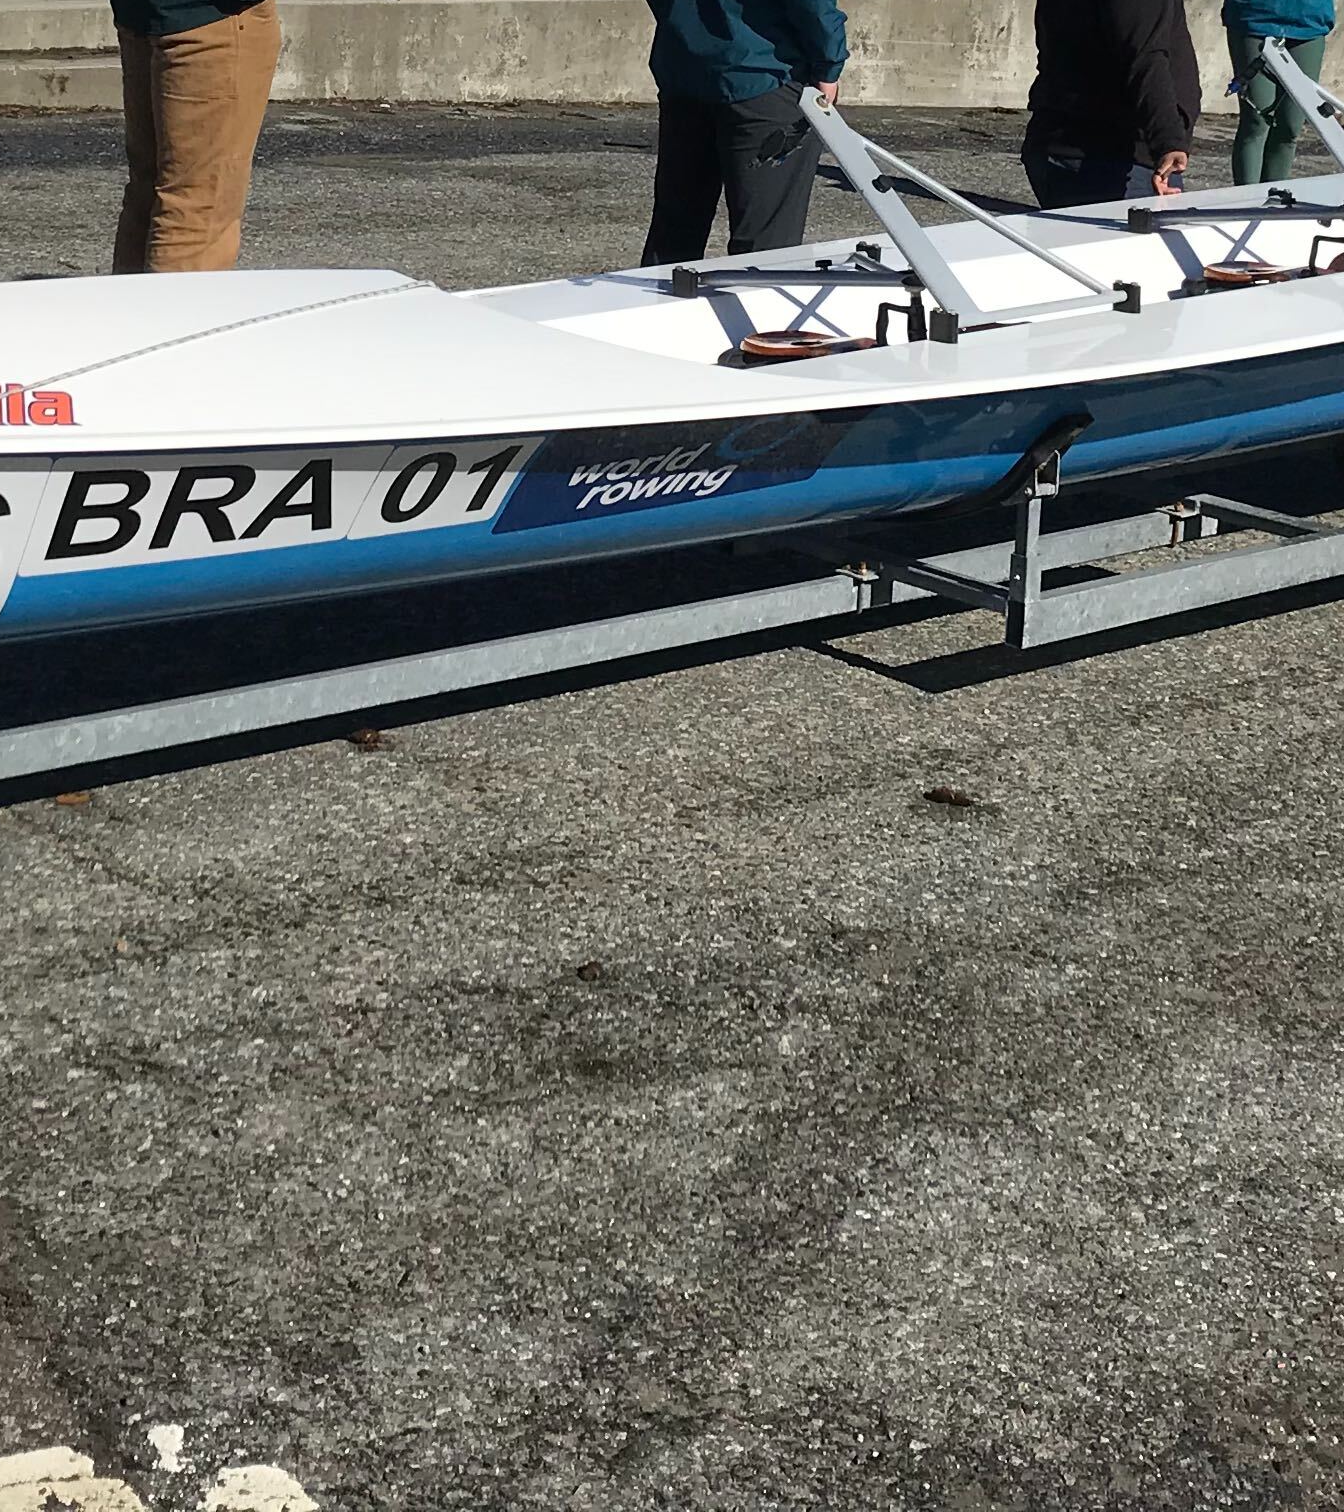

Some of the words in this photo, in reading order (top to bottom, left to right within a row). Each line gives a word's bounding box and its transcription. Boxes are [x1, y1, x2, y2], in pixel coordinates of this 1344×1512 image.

[568, 442, 712, 487] world
[576, 464, 739, 510] rowing
[45, 459, 333, 560] BRA
[380, 444, 524, 524] 01
